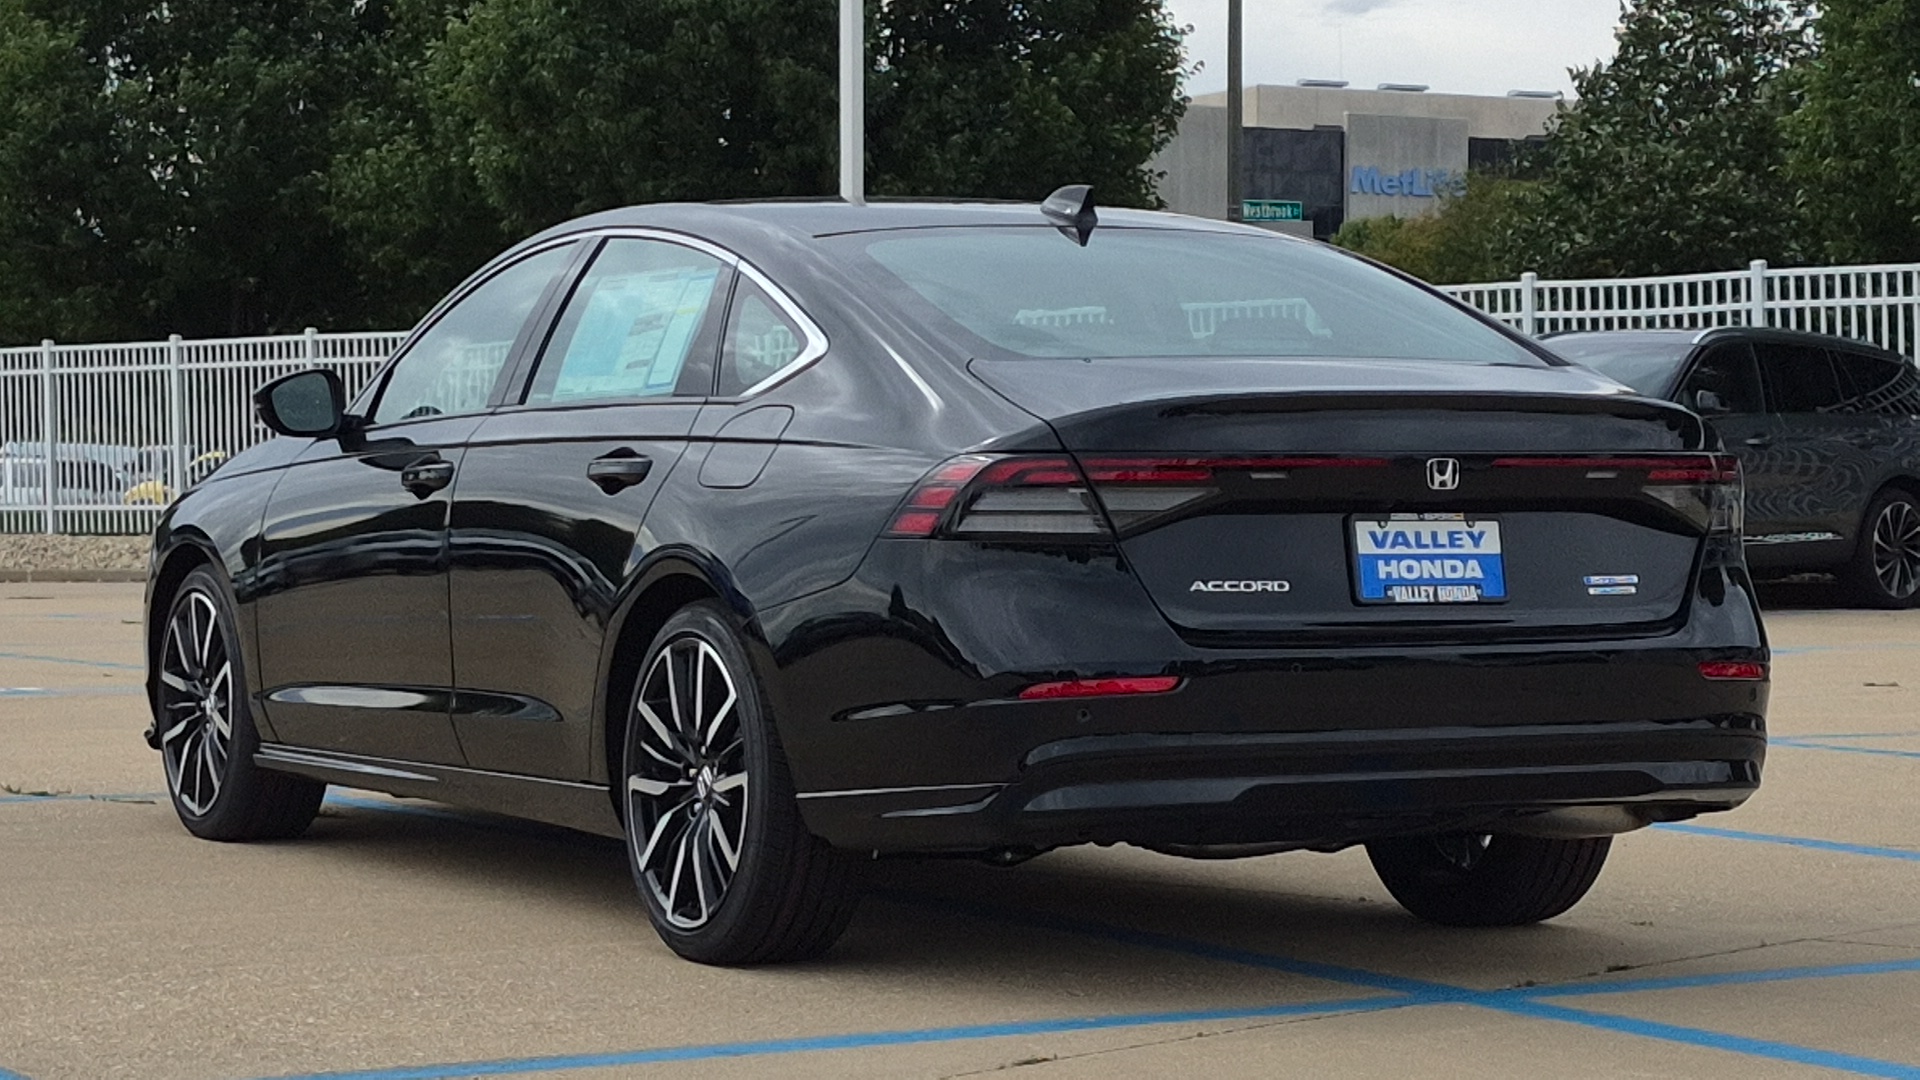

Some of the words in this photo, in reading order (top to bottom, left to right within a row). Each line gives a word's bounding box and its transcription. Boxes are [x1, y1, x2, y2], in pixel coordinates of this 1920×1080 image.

[1368, 530, 1486, 549] VALLEY
[1377, 559, 1484, 579] HONDA
[1189, 580, 1291, 592] ACCORD
[1392, 586, 1435, 602] VALLEY
